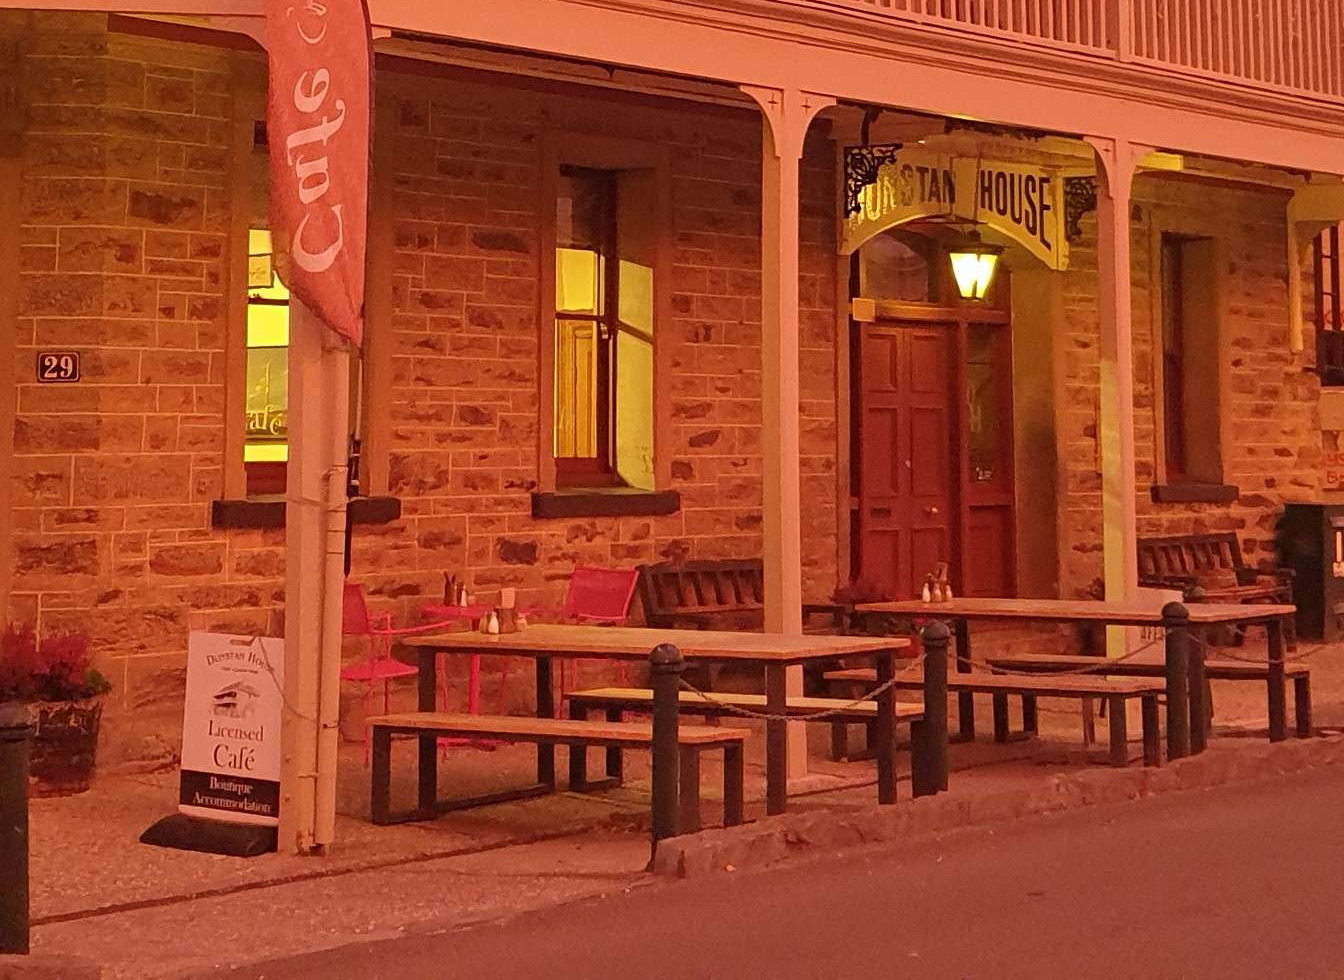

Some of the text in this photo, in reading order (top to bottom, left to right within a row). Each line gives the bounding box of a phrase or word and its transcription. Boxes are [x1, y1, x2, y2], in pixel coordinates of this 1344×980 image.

[980, 170, 1053, 252] HOUSE
[44, 355, 73, 378] 29
[208, 719, 264, 742] Licensed
[213, 743, 255, 771] Café
[209, 776, 254, 795] Boutique
[192, 790, 272, 813] Accommodation
